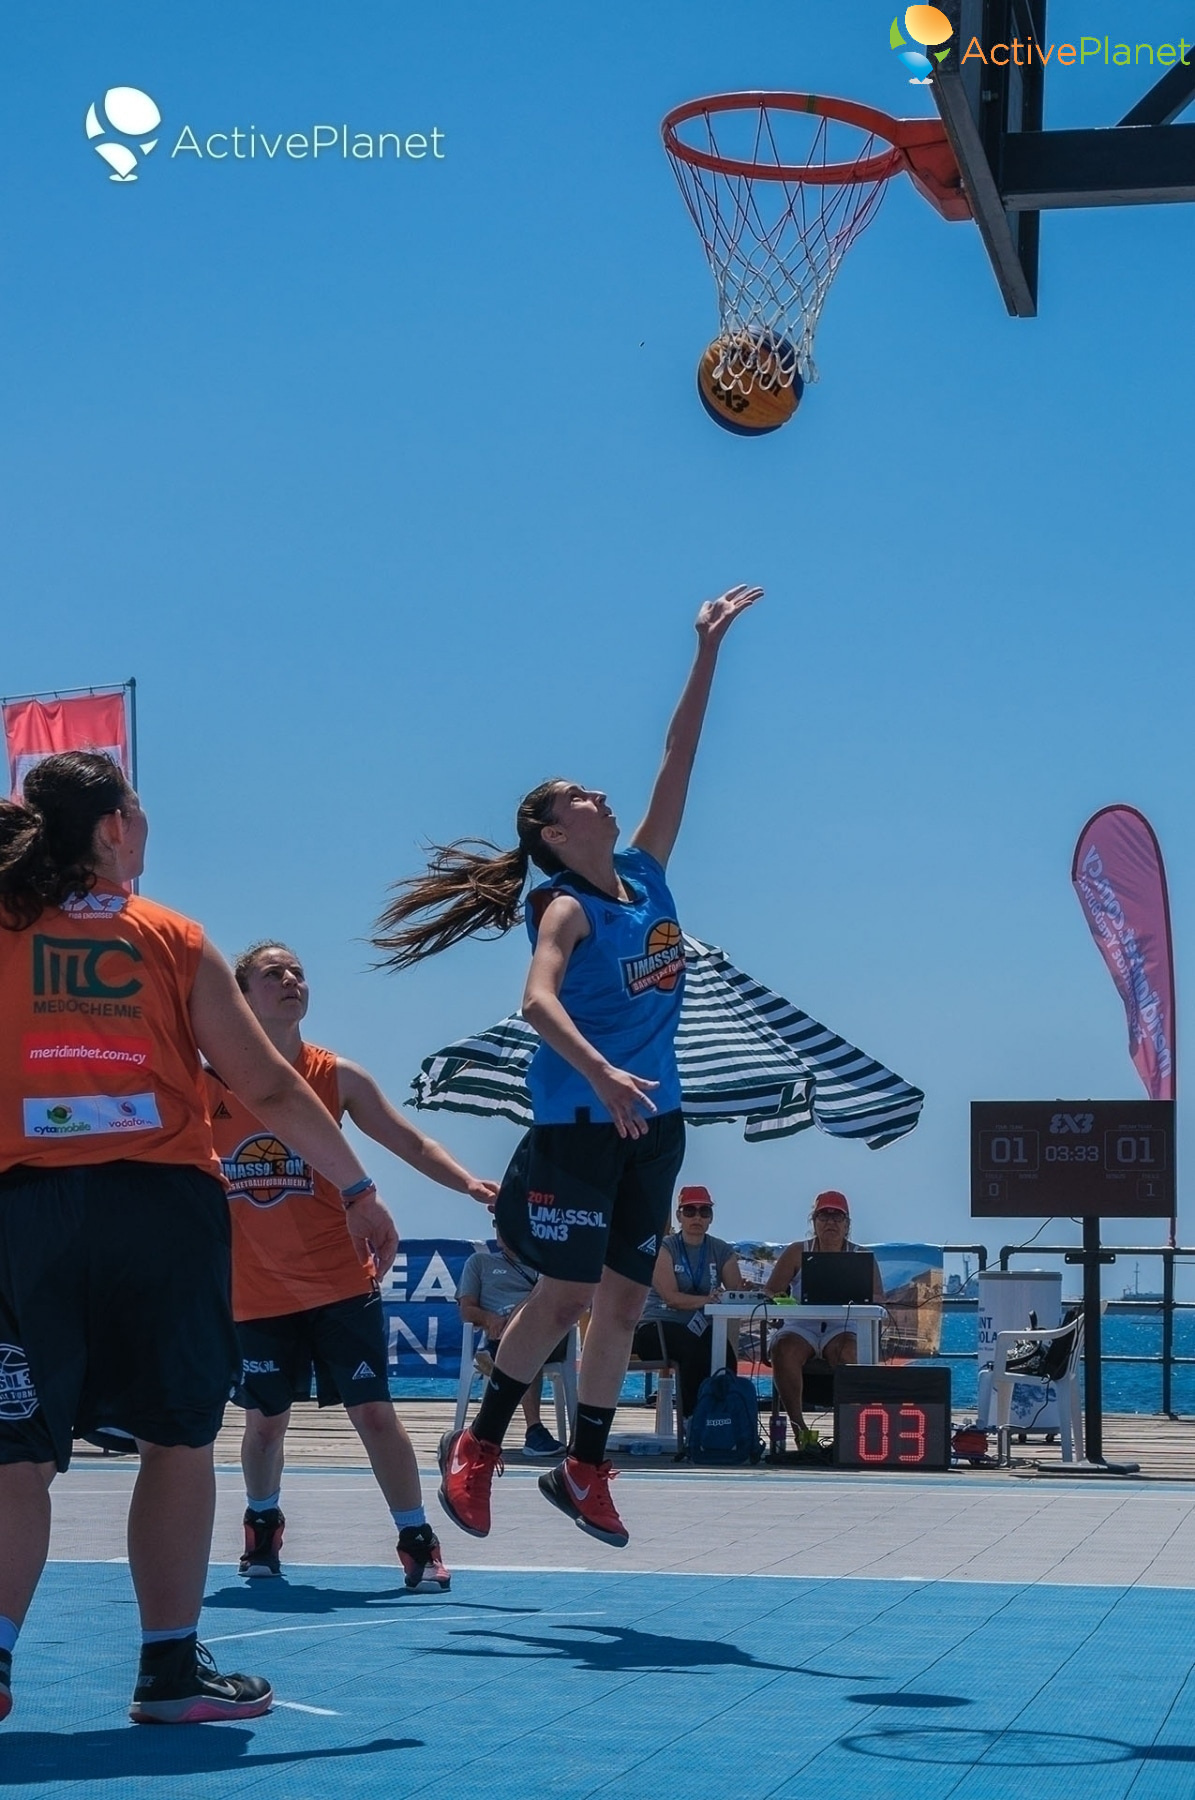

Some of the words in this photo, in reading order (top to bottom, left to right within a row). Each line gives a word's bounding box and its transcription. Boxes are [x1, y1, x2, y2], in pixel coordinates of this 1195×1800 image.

[33, 1000, 143, 1019] MEDOCHEMIE
[34, 1122, 91, 1135] cytamobile
[991, 1137, 1028, 1163] 01
[1045, 1145, 1099, 1162] 03:33
[1116, 1137, 1155, 1163] 01
[528, 1191, 555, 1205] 2017
[988, 1183, 999, 1197] 0
[1146, 1183, 1155, 1197] 1
[527, 1202, 607, 1229] LIMASSOL
[530, 1219, 569, 1242] 3ON3
[858, 1407, 926, 1462] 03
